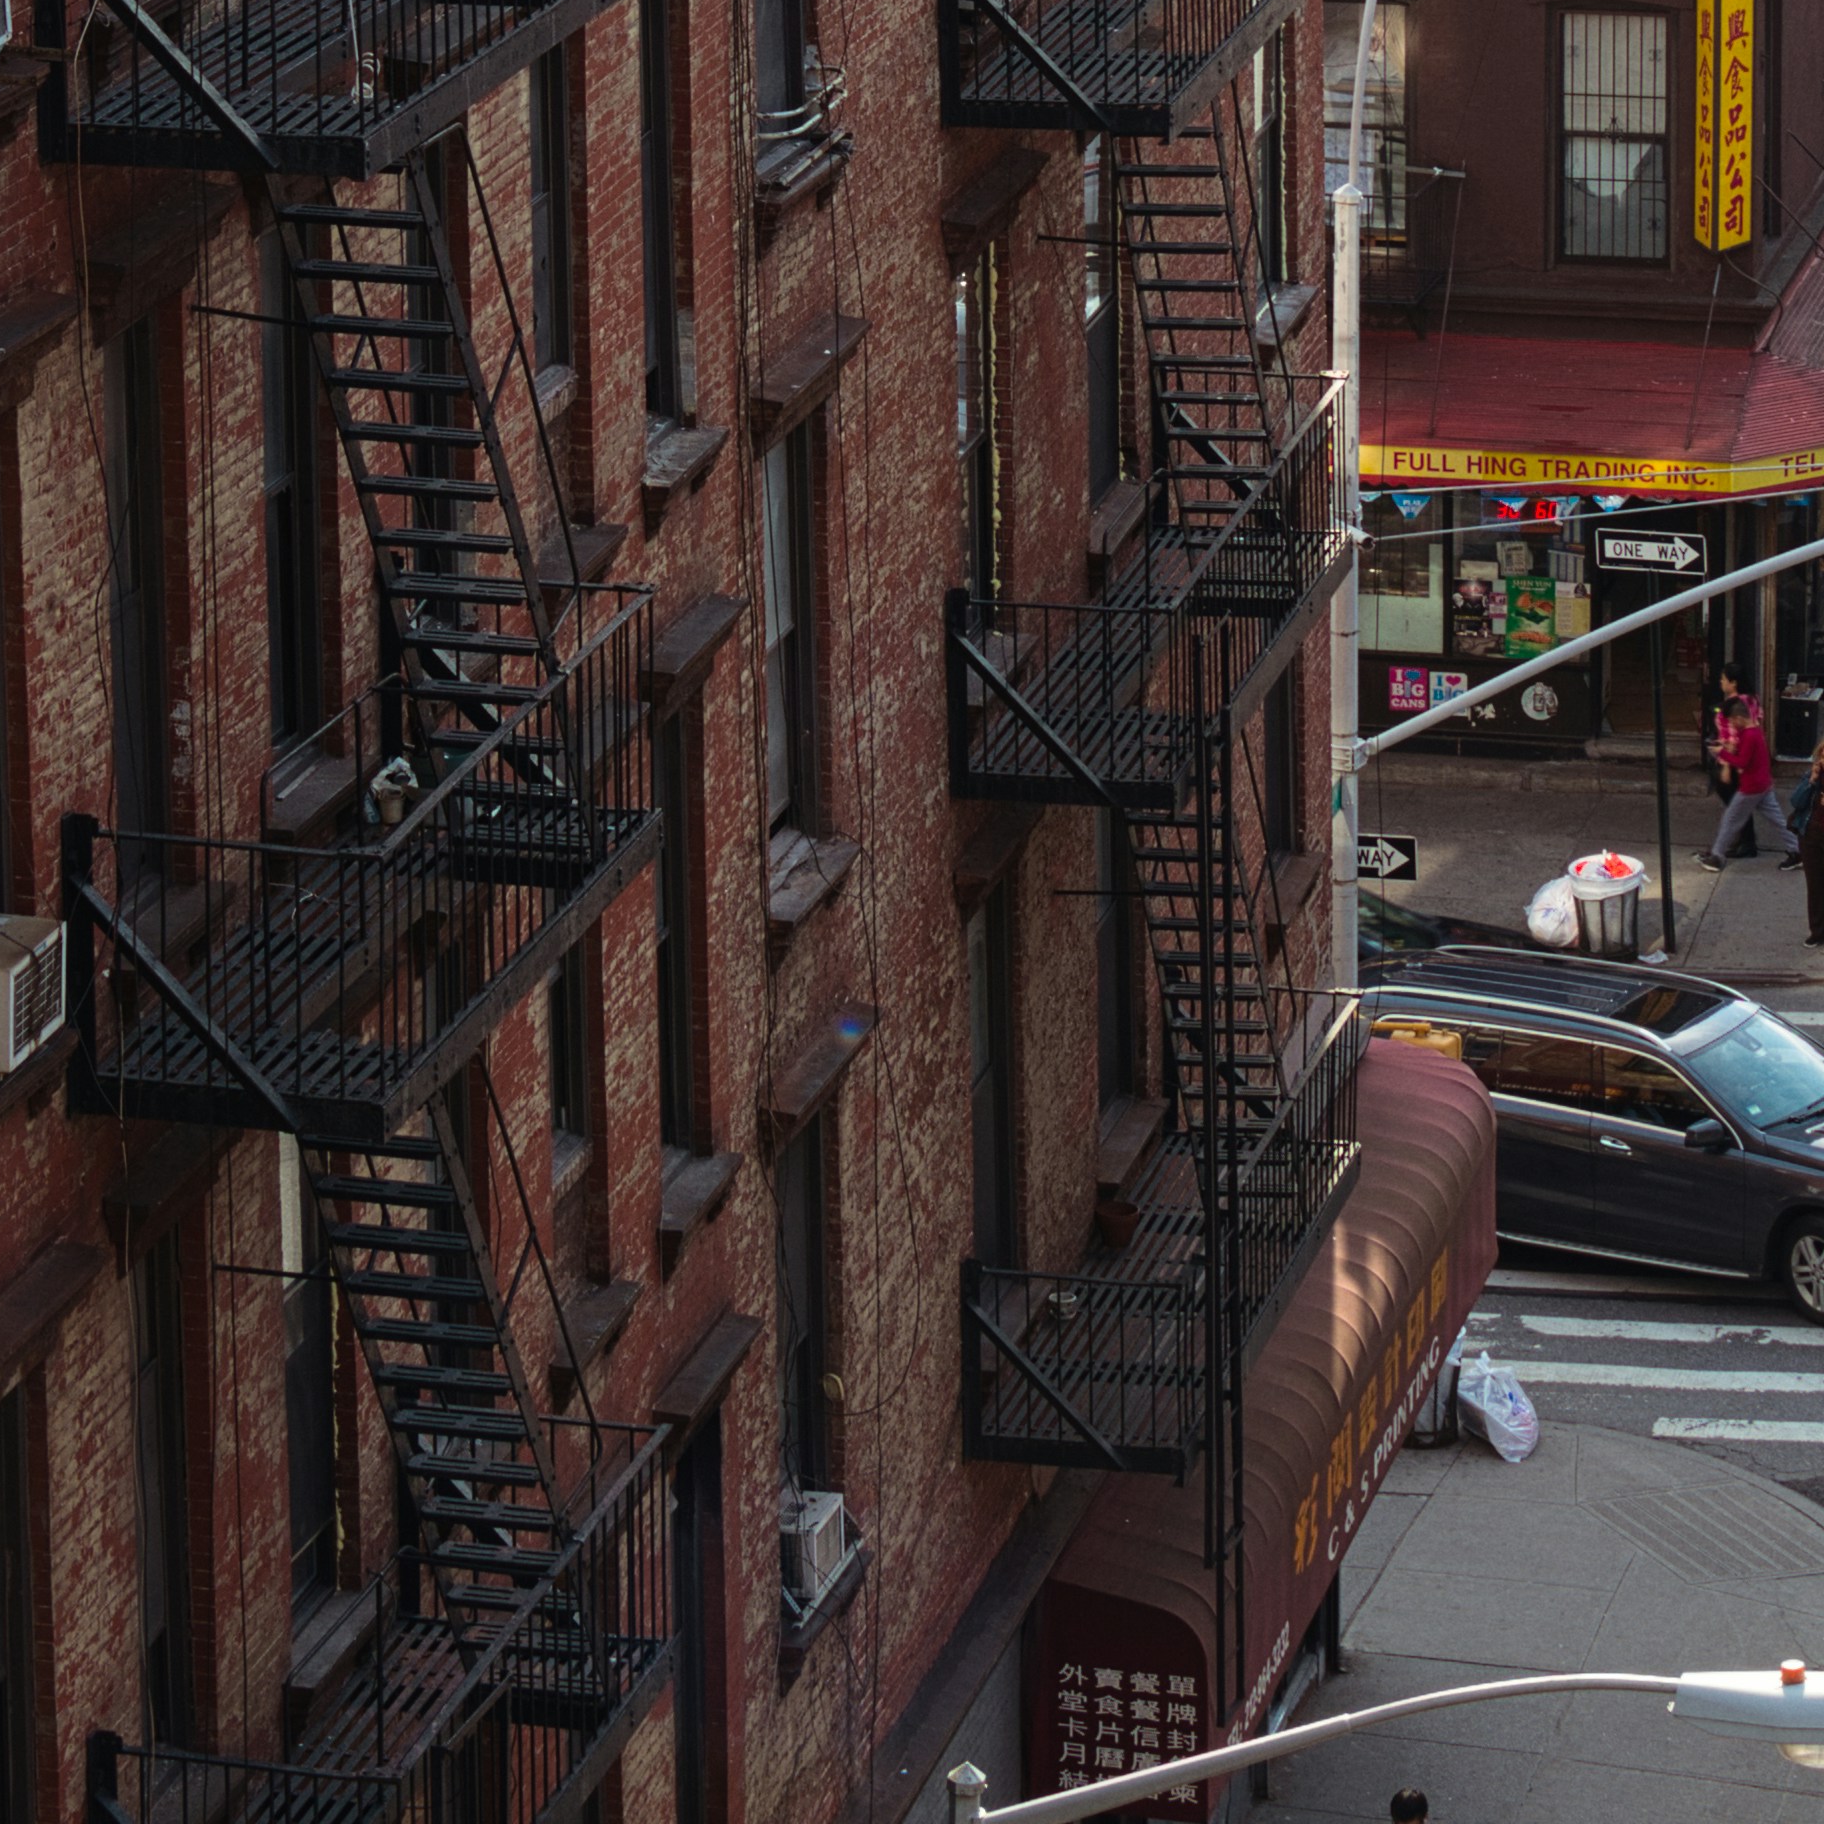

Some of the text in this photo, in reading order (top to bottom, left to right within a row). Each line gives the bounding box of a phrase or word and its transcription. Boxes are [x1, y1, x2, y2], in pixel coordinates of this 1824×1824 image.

[1393, 451, 1716, 487] FULL HING TRADING INC.
[1612, 541, 1689, 562] ONE WAY
[1395, 669, 1404, 681] I
[1390, 697, 1426, 709] CANS
[1358, 850, 1396, 868] WAY
[1327, 1335, 1441, 1562] C & S PRINTING
[1058, 1717, 1198, 1753] 卡片信封
